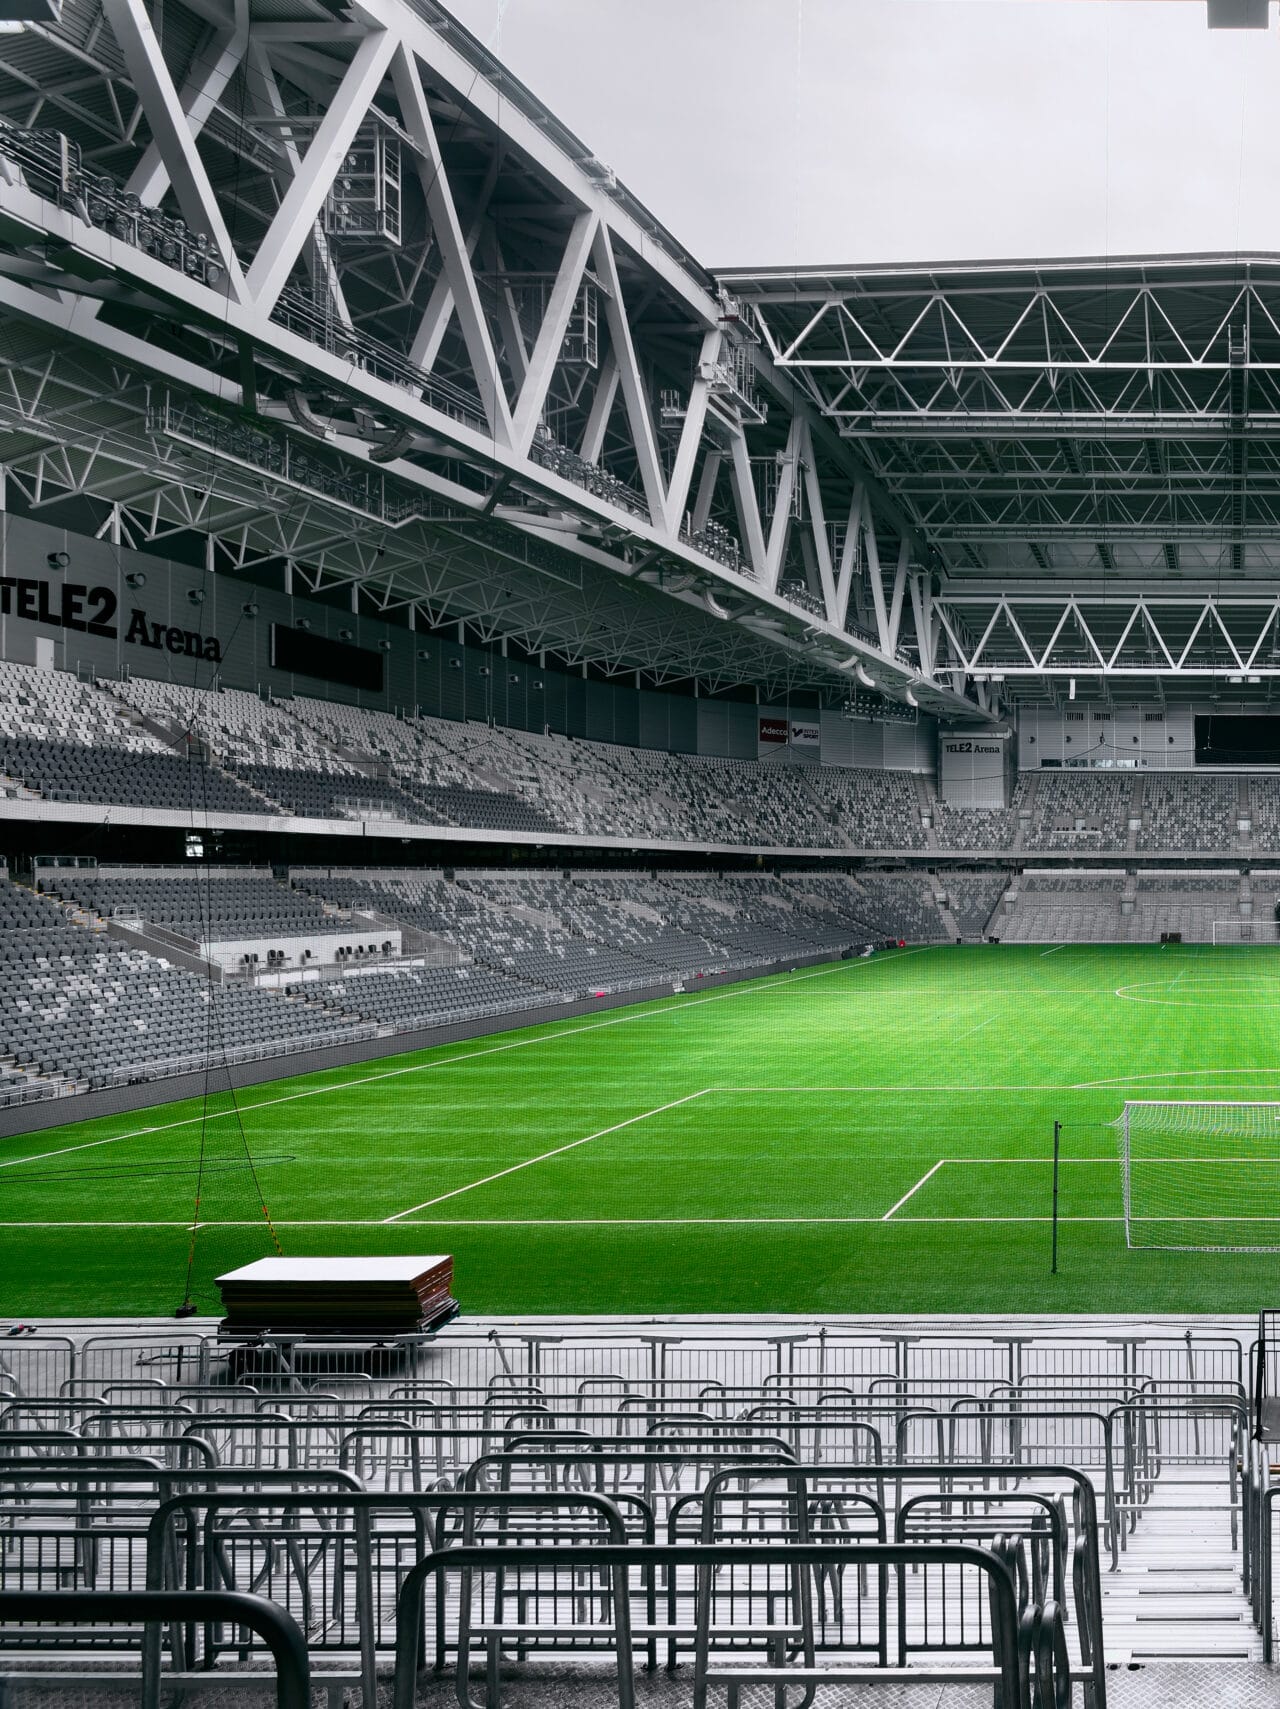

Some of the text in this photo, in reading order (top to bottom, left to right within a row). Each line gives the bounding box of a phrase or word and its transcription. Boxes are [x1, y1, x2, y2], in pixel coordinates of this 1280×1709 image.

[0, 576, 223, 664] TELE2 Arena
[761, 726, 788, 736] Adecco
[945, 742, 1001, 754] TELE2 Arena
